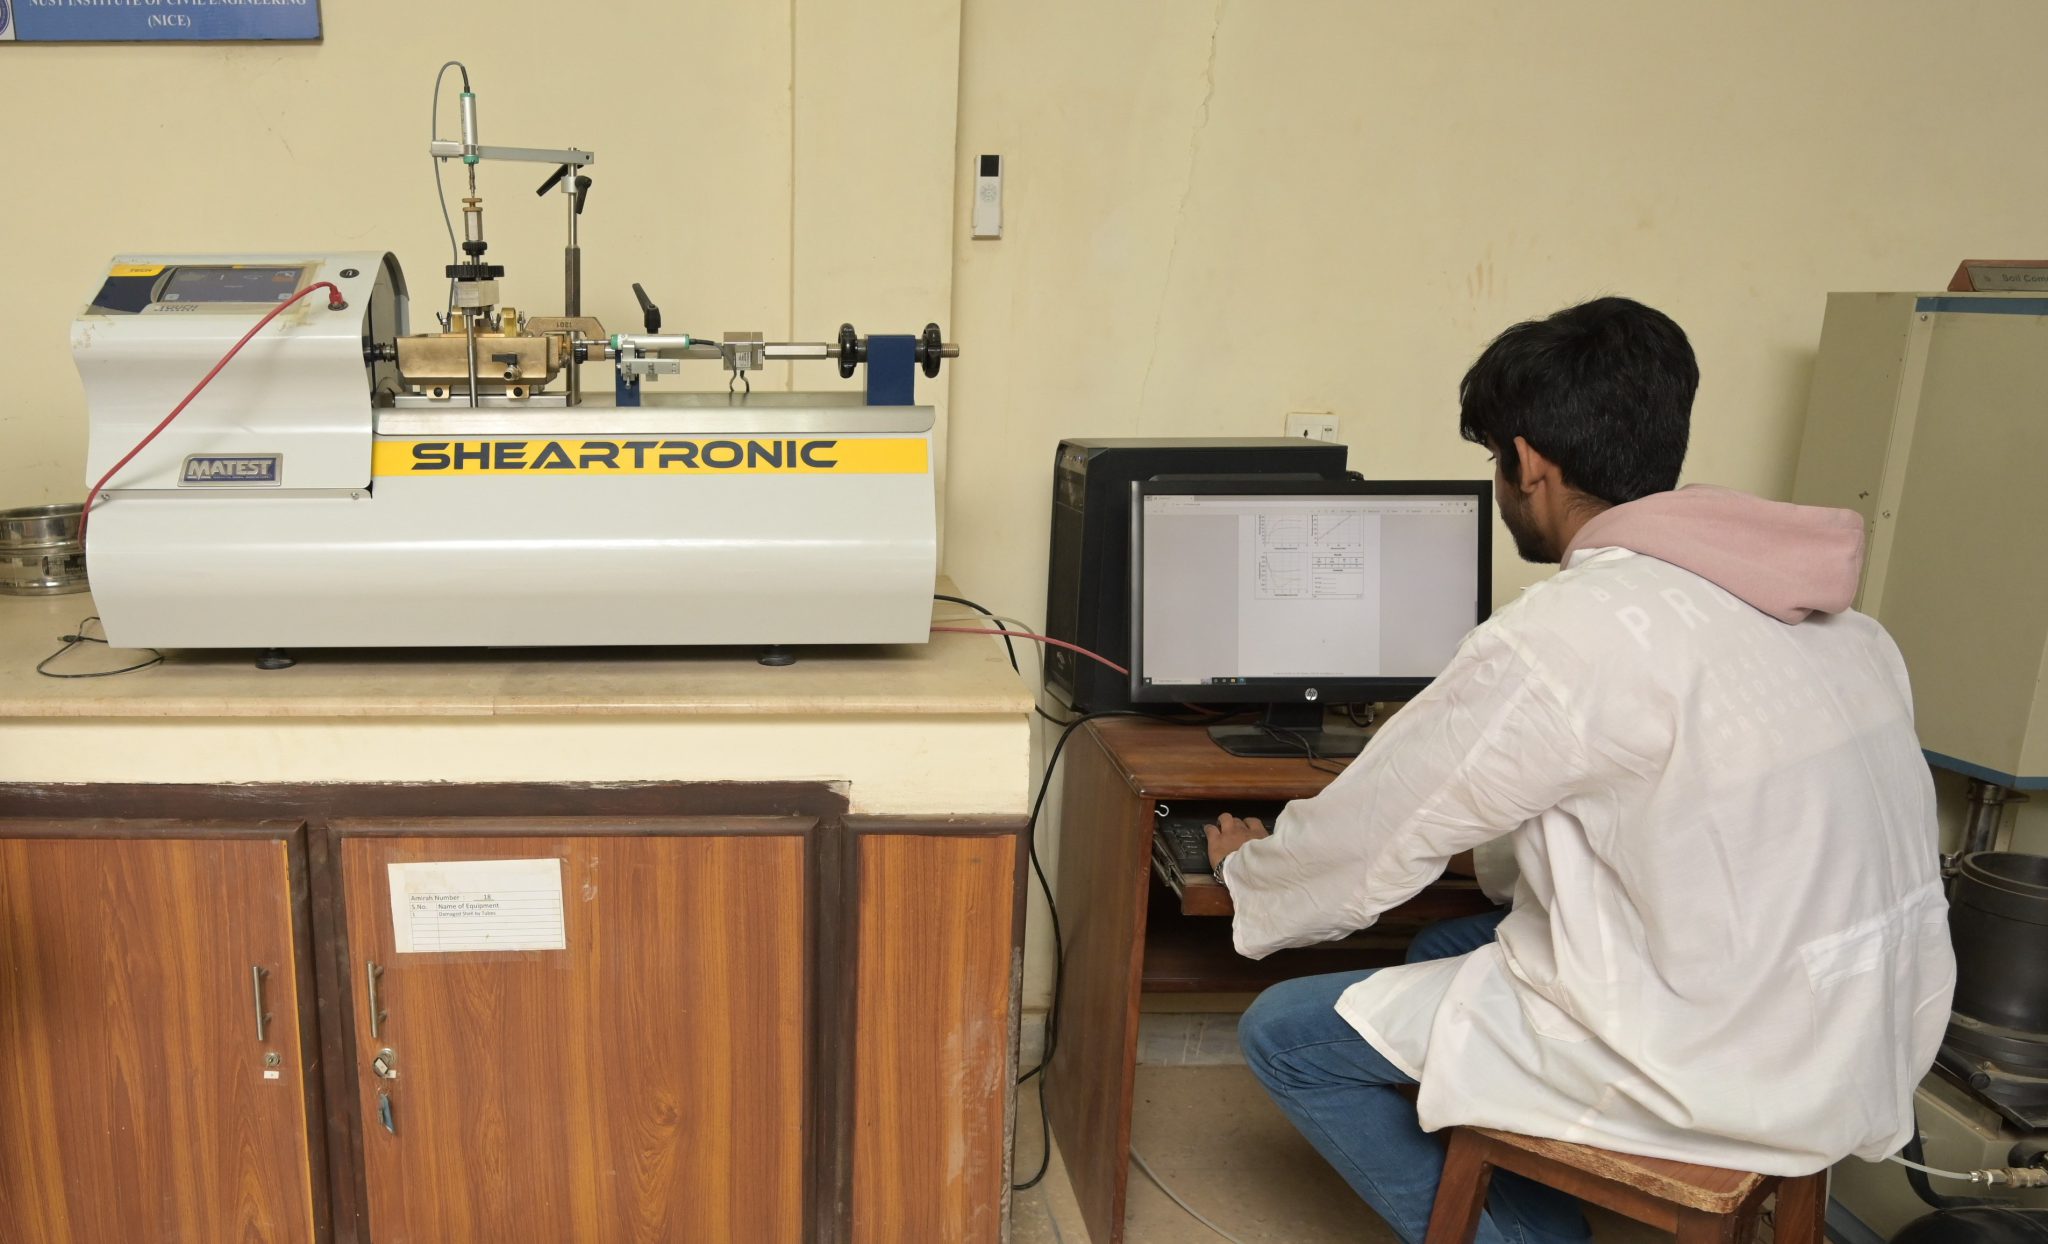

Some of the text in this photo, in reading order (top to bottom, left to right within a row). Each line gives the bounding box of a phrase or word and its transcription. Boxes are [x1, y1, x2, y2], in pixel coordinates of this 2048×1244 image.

[147, 14, 192, 28] (NICE)
[411, 440, 838, 470] SHEARTRONIC
[187, 459, 274, 477] MATEST
[465, 902, 499, 910] Equipment
